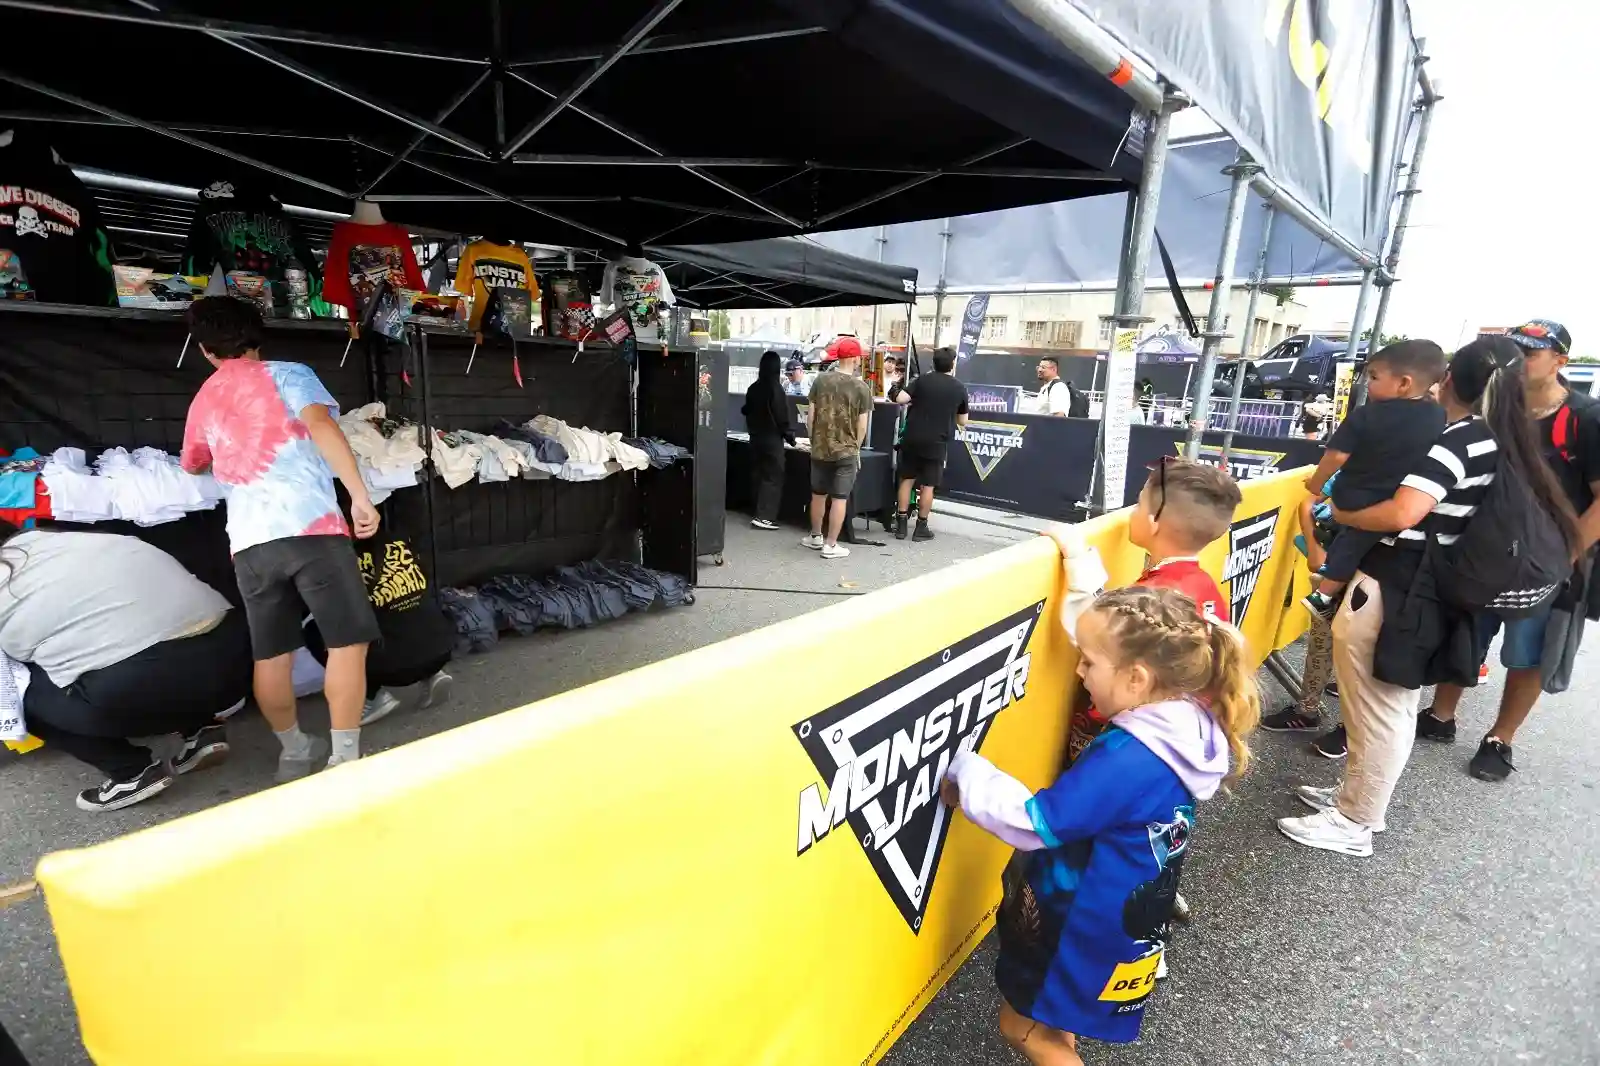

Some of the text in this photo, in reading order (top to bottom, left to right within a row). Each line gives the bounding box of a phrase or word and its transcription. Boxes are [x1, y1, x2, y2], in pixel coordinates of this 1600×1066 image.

[25, 188, 80, 228] DIGGER
[44, 220, 74, 236] TEAM
[954, 429, 1023, 449] MONSTER
[971, 443, 1003, 457] JAM
[1221, 532, 1276, 583] MONSTER
[1231, 563, 1261, 605] JAM
[796, 651, 1032, 857] MONSTER
[1112, 976, 1143, 991] DE
